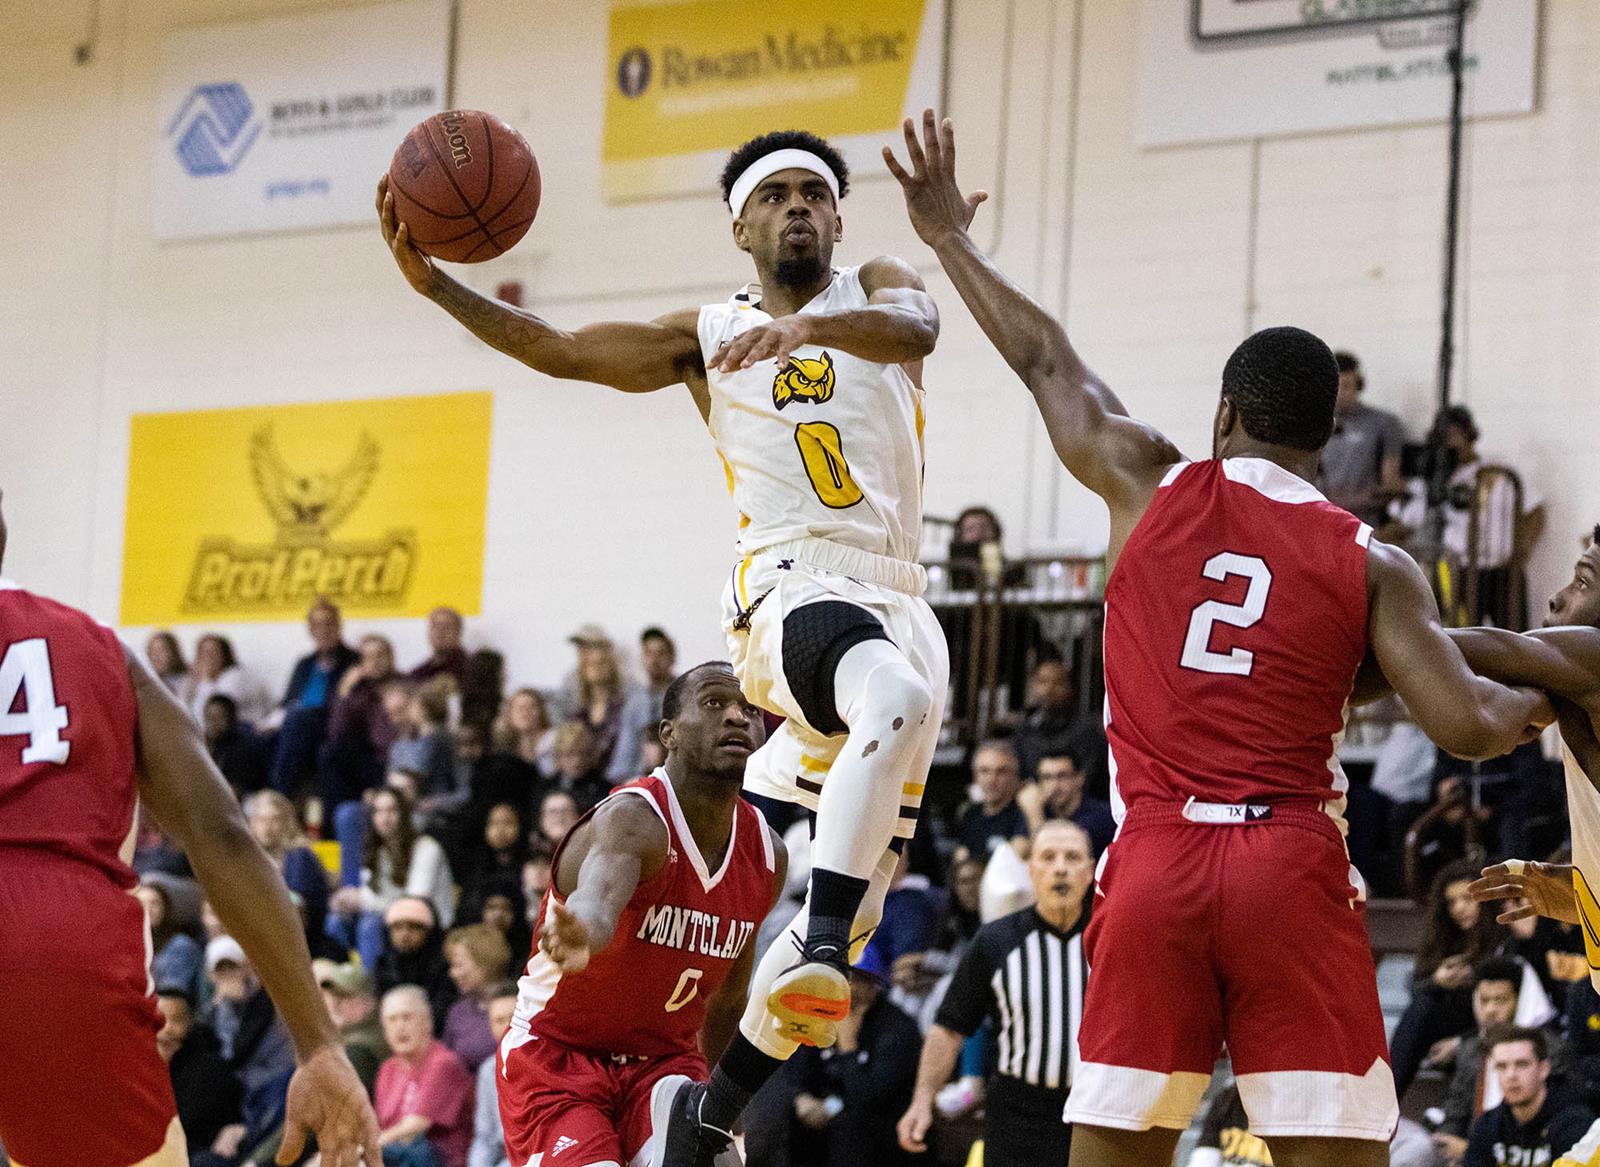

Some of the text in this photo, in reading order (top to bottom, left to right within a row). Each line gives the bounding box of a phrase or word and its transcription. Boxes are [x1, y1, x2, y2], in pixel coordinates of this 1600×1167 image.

[794, 420, 865, 509] 0
[1178, 549, 1273, 678] 2
[0, 636, 71, 766] 4
[664, 967, 703, 1013] 0
